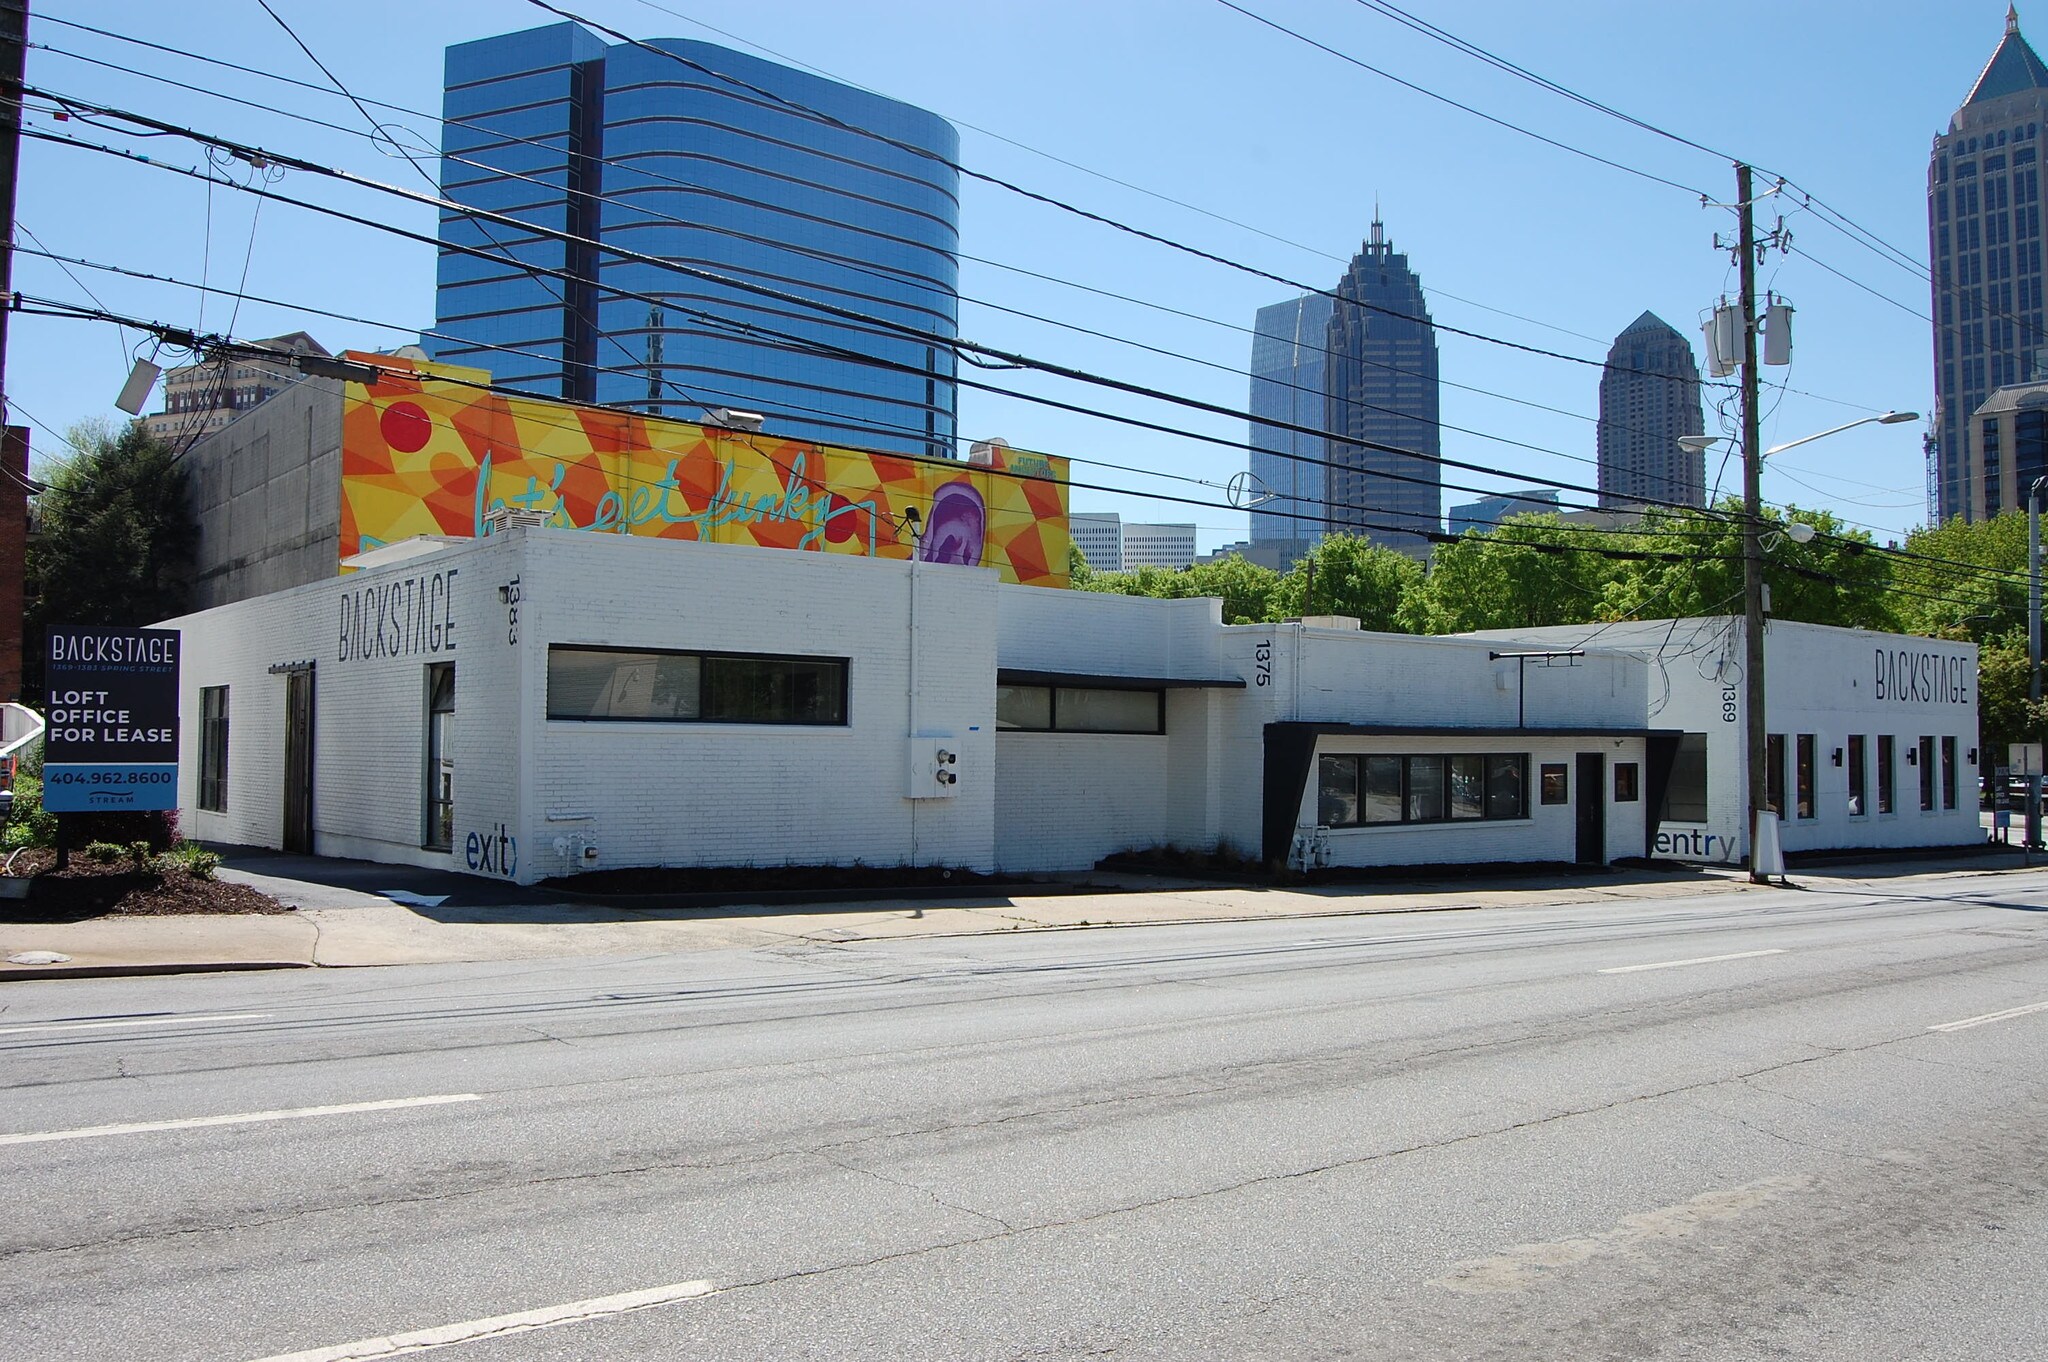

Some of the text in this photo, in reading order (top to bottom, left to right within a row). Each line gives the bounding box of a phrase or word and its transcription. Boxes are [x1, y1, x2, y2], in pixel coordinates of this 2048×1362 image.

[698, 451, 876, 557] funky
[338, 569, 458, 662] BACKSTAGE
[508, 573, 521, 646] 1383
[52, 634, 175, 664] BACKSTAGE
[1255, 639, 1271, 688] 1375
[100, 664, 136, 672] SPRING
[138, 665, 174, 673] STREET
[1875, 648, 1968, 704] BACKSTAGE
[51, 690, 109, 705] LOFT
[1722, 684, 1737, 723] 1369
[51, 709, 130, 724] OFFICE
[50, 728, 173, 742] FOR LEASE
[50, 772, 172, 785] 404.962.8600
[89, 796, 135, 805] STREAM
[466, 823, 509, 876] exit
[1654, 829, 1736, 861] entry
